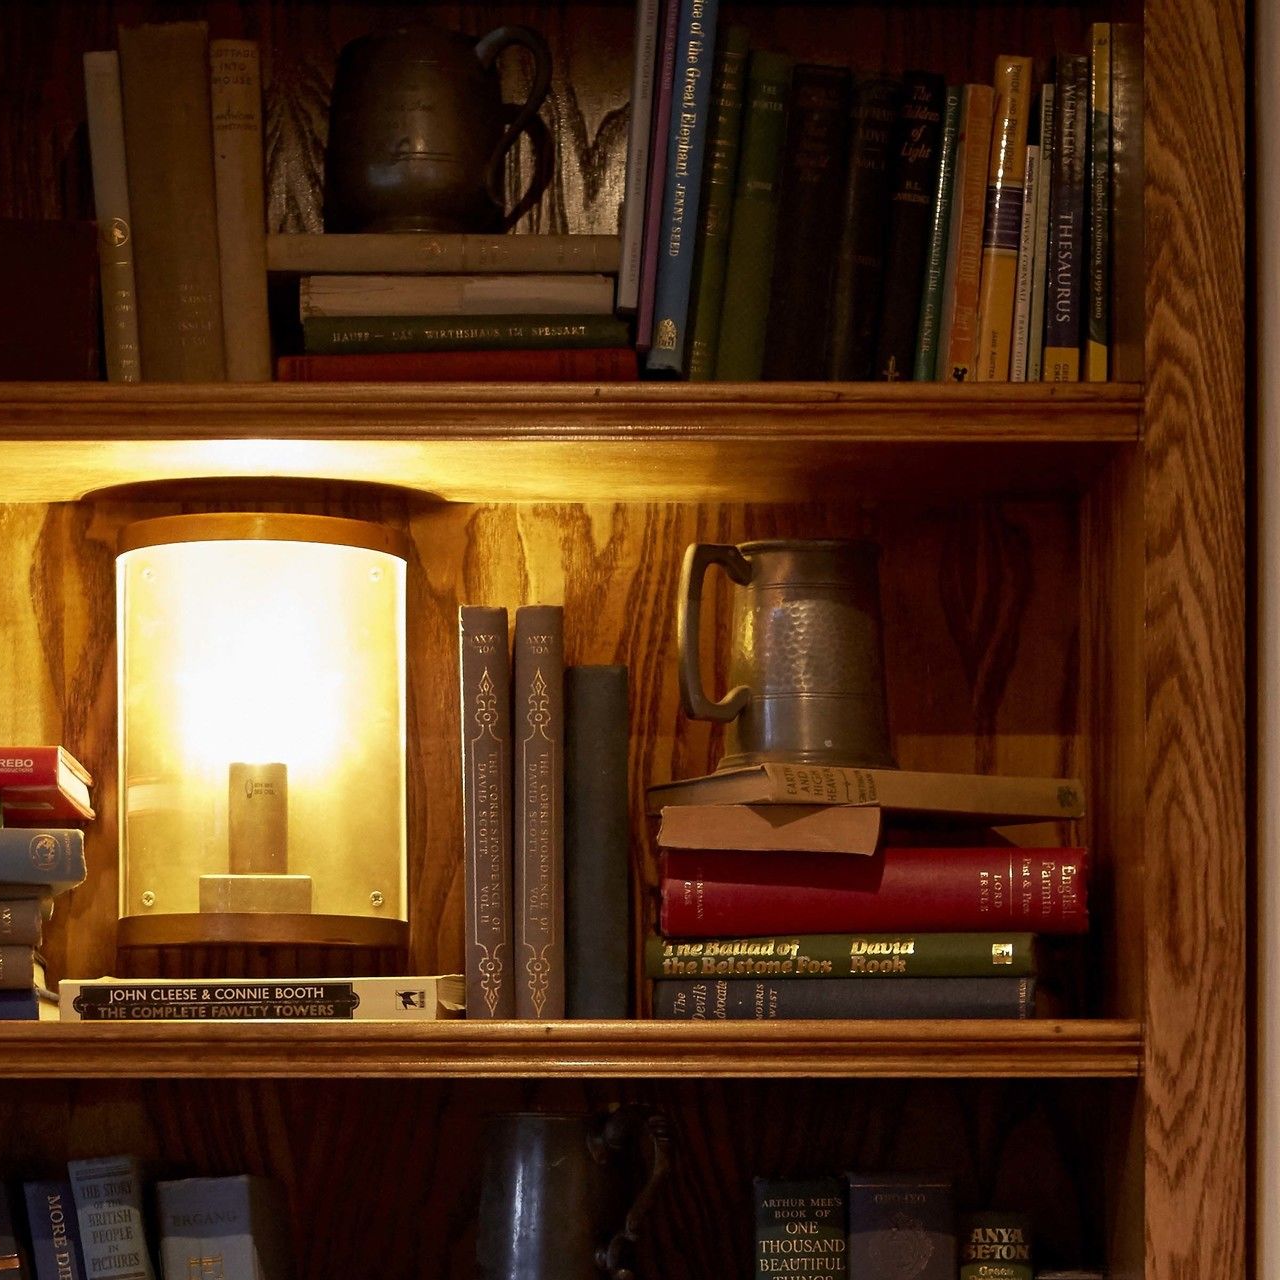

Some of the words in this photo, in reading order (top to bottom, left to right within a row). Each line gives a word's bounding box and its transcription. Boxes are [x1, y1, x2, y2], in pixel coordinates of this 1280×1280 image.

[689, 22, 704, 39] of
[687, 40, 704, 64] the
[682, 66, 701, 108] Great
[1009, 64, 1023, 93] PRIDE
[674, 112, 697, 178] Elephant
[1004, 118, 1019, 173] PREJUDICE
[671, 183, 687, 223] JENNY
[667, 226, 682, 257] SEED
[1056, 212, 1074, 322] THESAURUS
[927, 268, 940, 293] TIME
[921, 303, 934, 354] GARNER
[477, 763, 487, 804] DAVID
[528, 763, 538, 803] DAVID
[800, 770, 810, 794] AND
[663, 940, 701, 957] The
[704, 939, 774, 957] Ballad
[777, 939, 801, 959] of
[850, 939, 915, 956] David
[663, 957, 701, 974] the
[703, 957, 793, 974] Belstone
[796, 957, 832, 974] Fox
[849, 957, 907, 973] Rook
[109, 988, 149, 1002] JOHN
[151, 988, 198, 1001] CLEESE
[201, 988, 211, 1000] &
[214, 987, 269, 1000] CONNIE
[275, 986, 324, 1000] BOOTH
[673, 991, 686, 1015] The
[768, 988, 777, 1019] WEST
[98, 1006, 127, 1019] THE
[130, 1005, 209, 1019] COMPLETE
[212, 1004, 271, 1018] FAWLTY
[274, 1003, 335, 1017] TOWERS
[81, 1184, 100, 1198] THE
[761, 1198, 806, 1208] ARTHUR
[810, 1196, 843, 1207] MEE'S
[48, 1194, 67, 1248] MORE
[88, 1210, 132, 1227] BRITISH
[774, 1210, 807, 1219] BOOK
[815, 1209, 832, 1219] OF
[92, 1227, 134, 1243] PEOPLE
[785, 1221, 819, 1235] ONE
[971, 1227, 1024, 1243] ANYA
[108, 1244, 119, 1252] IN
[758, 1239, 846, 1254] THOUSAND
[964, 1244, 1032, 1260] SETON
[92, 1252, 140, 1273] PICTURES
[759, 1257, 846, 1272] BEAUTIFUL
